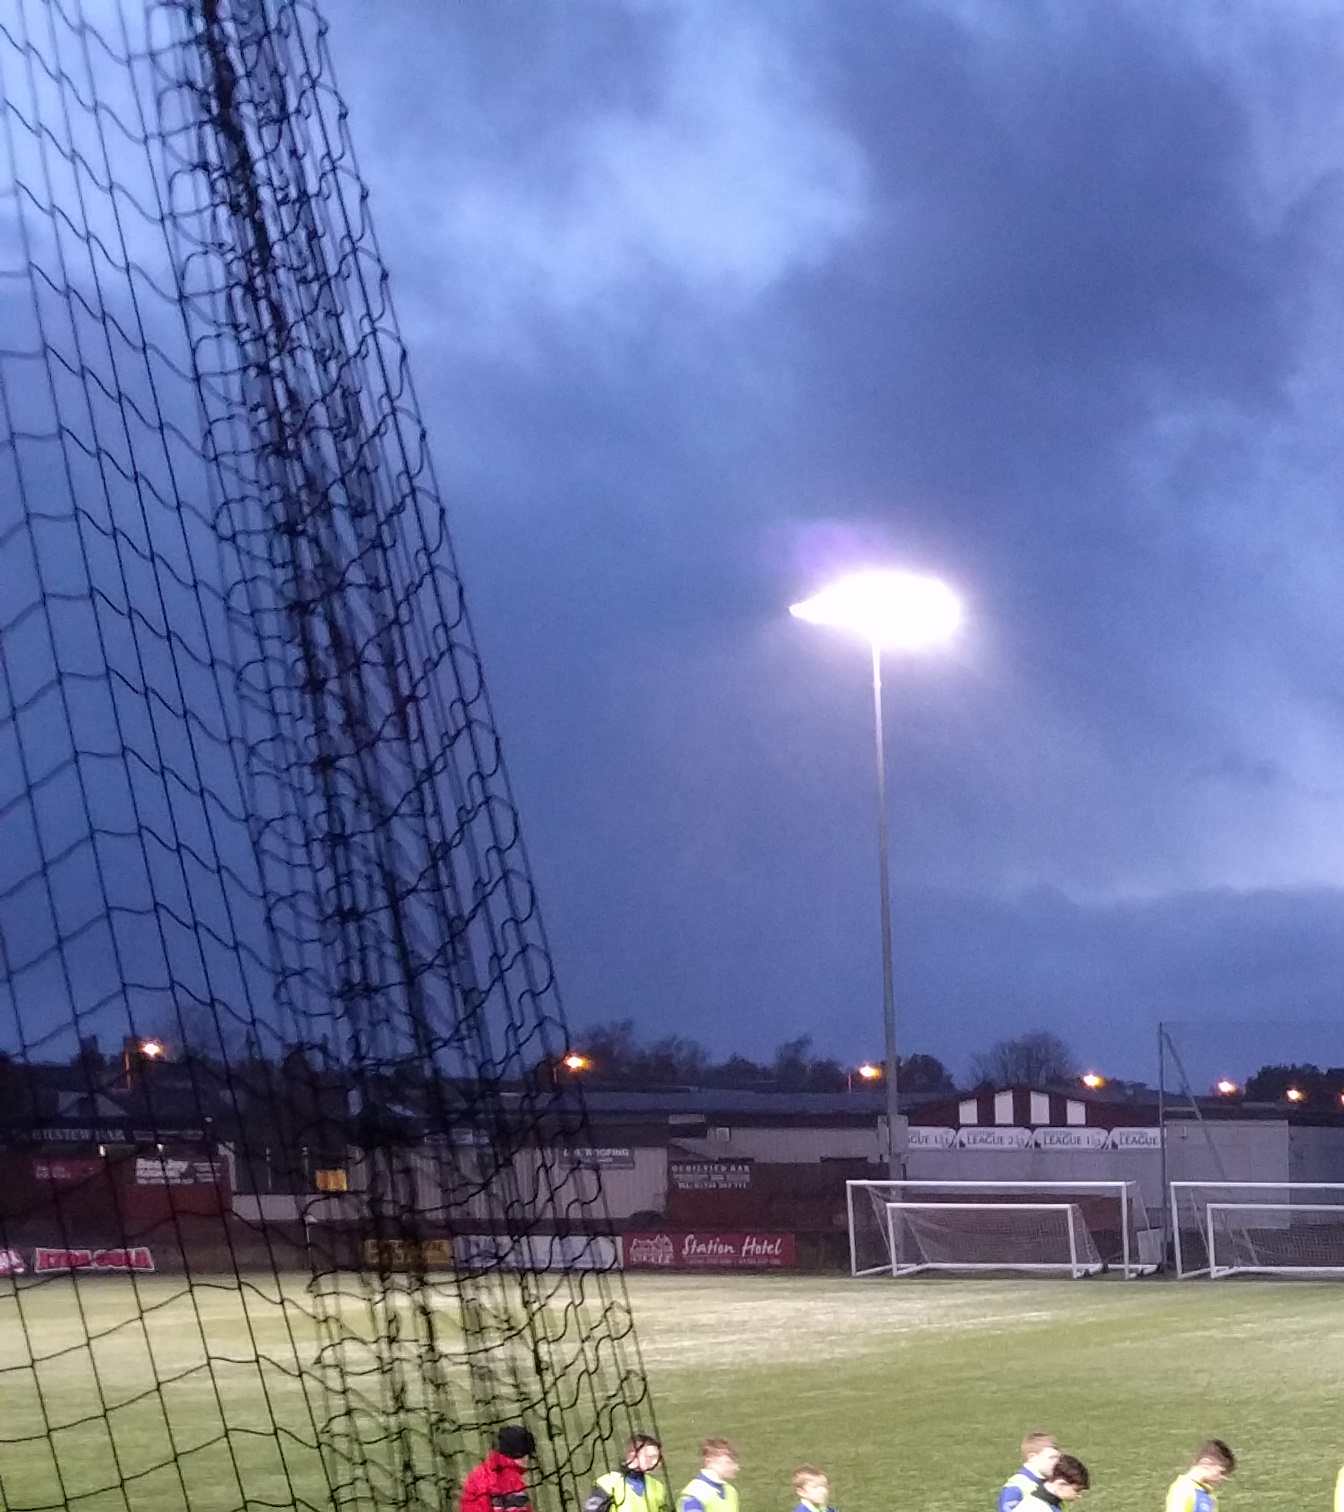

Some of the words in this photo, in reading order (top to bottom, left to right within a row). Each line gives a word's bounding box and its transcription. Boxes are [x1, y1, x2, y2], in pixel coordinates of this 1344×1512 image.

[967, 1135, 1004, 1145] LEAGUE
[1044, 1135, 1081, 1145] LEAGUE
[682, 1234, 736, 1256] Station
[741, 1234, 782, 1257] Hotel
